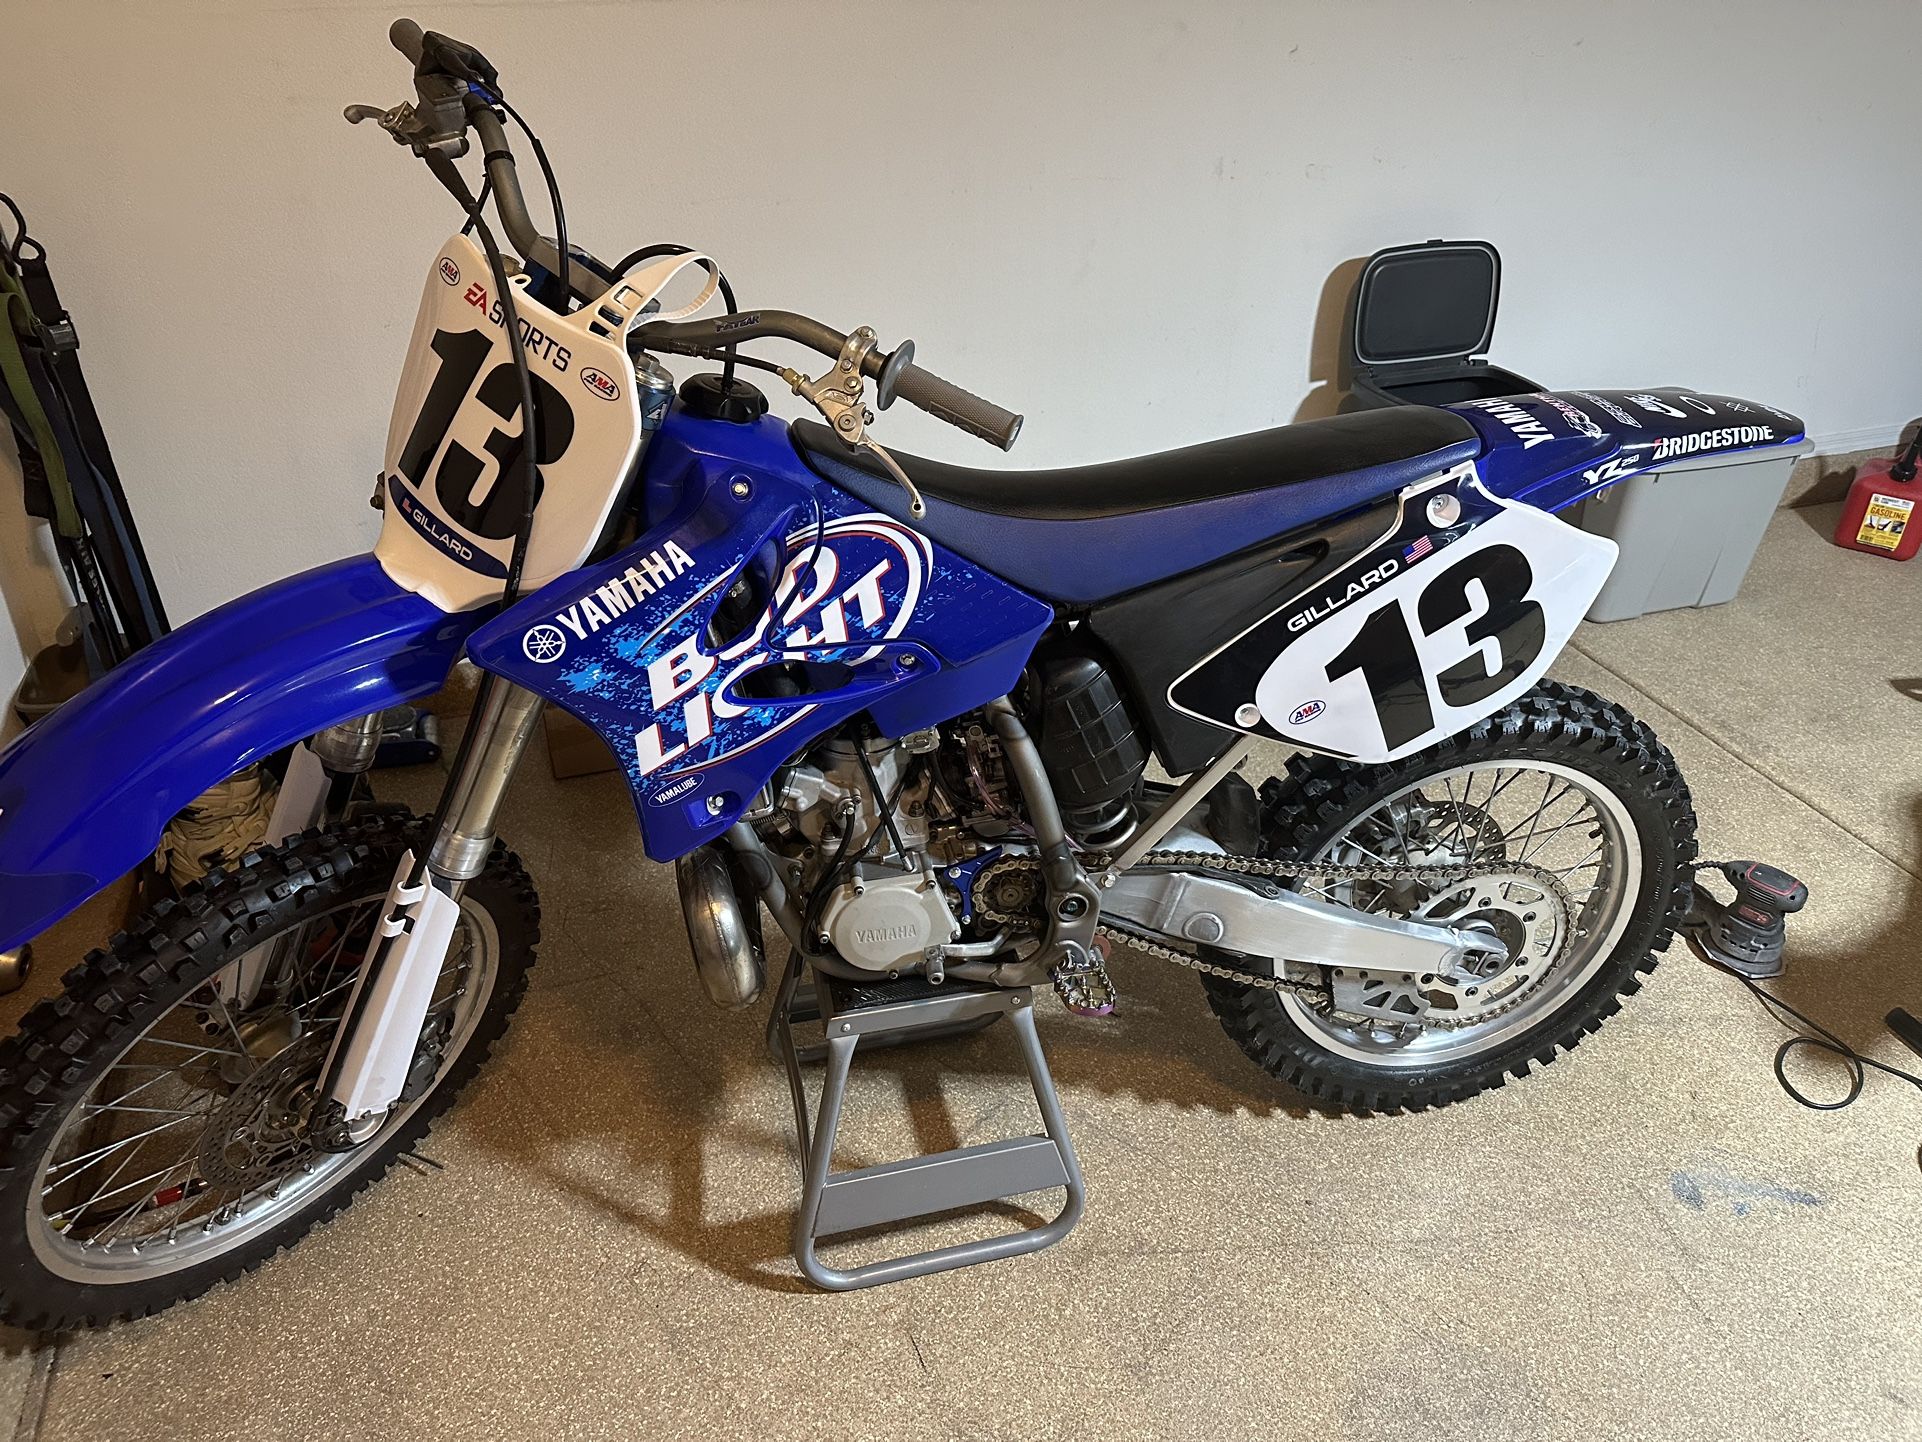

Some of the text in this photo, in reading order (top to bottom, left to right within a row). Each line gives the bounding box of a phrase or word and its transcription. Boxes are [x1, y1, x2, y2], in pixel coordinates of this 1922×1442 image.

[441, 262, 458, 280] AMA
[464, 282, 572, 373] EA SORTS
[585, 372, 616, 395] AMA
[398, 328, 575, 540] 13
[1463, 396, 1555, 450] YAMAH
[1652, 424, 1775, 461] BRIDGESTONE
[412, 509, 473, 561] GILLARD
[1869, 506, 1907, 521] GASOLINE
[555, 540, 696, 641] YAMAHA
[1286, 558, 1400, 632] GILLARD
[1323, 543, 1547, 753] 13
[1294, 702, 1321, 721] AMA
[654, 776, 698, 804] YAMALUBE
[854, 923, 918, 944] YAMAHA
